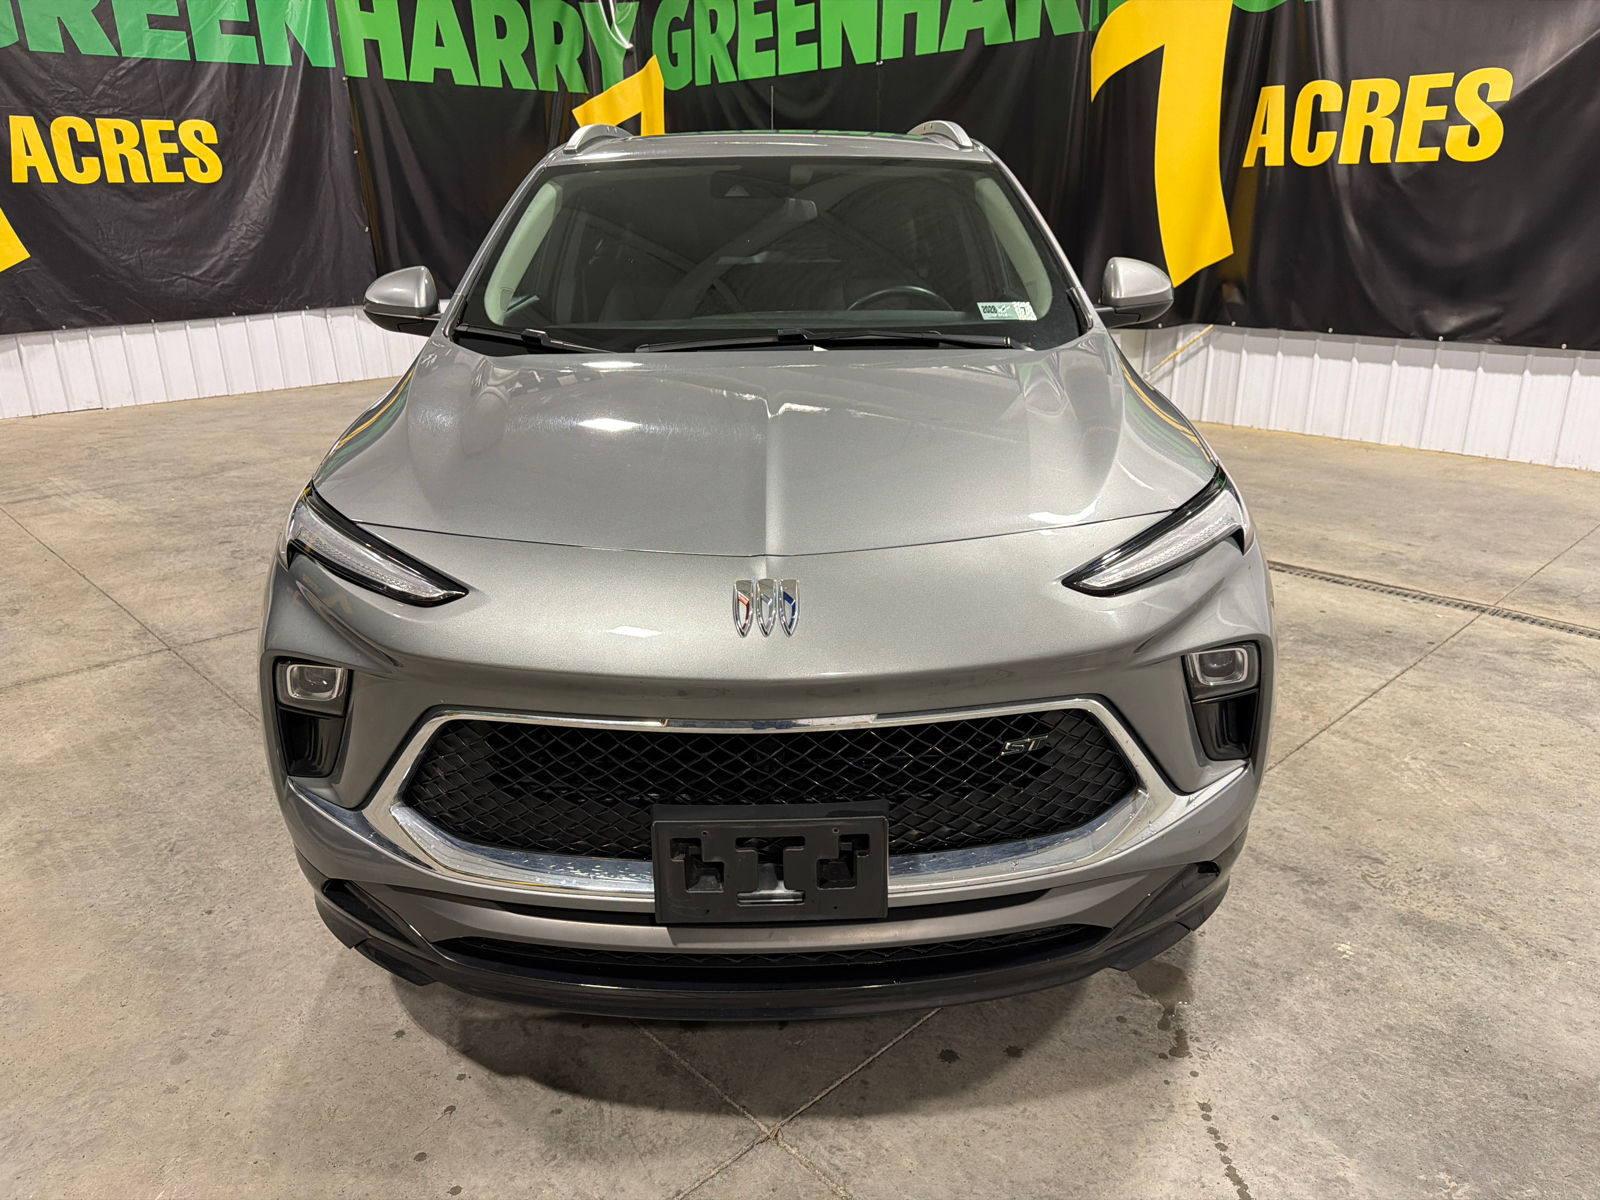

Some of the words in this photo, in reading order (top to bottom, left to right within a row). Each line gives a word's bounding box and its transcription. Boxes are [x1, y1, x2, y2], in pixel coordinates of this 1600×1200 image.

[0, 0, 336, 67] REEN
[337, 0, 640, 93] HARRY
[652, 0, 877, 90] GREEN
[9, 115, 223, 184] ACRES
[1242, 67, 1514, 167] ACRES
